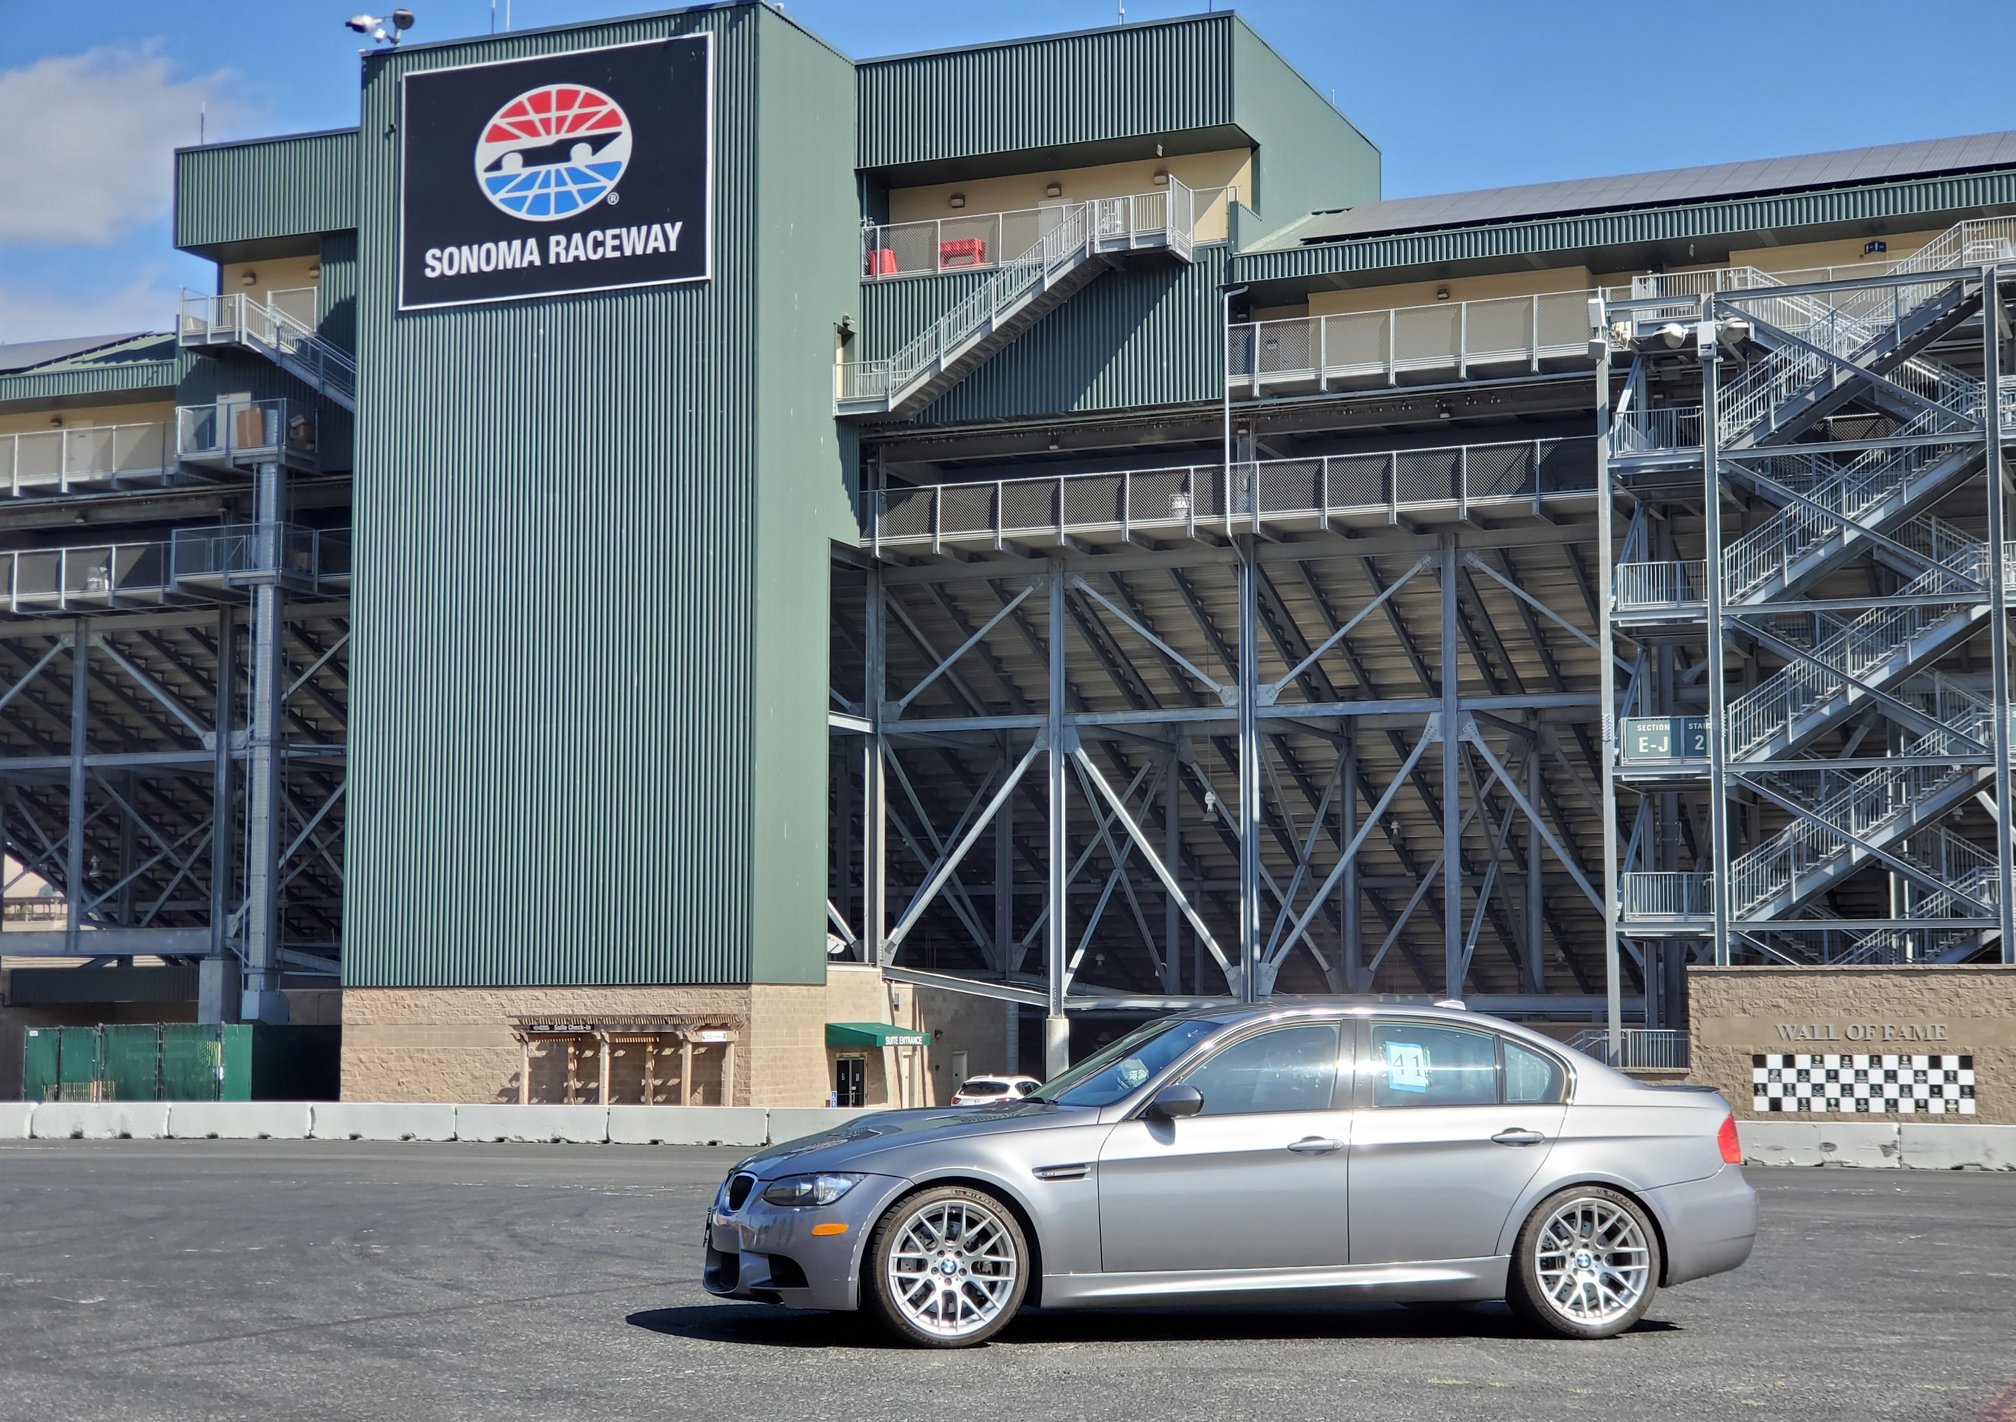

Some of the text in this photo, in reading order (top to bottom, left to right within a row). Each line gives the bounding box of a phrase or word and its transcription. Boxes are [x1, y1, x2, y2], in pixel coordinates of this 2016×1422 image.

[424, 221, 682, 278] SONOMA RACEWAY
[1637, 723, 1670, 731] SECTION
[1638, 736, 1669, 752] E-J
[1775, 1023, 1948, 1041] WALL OF FAME
[1392, 1052, 1423, 1077] 41
